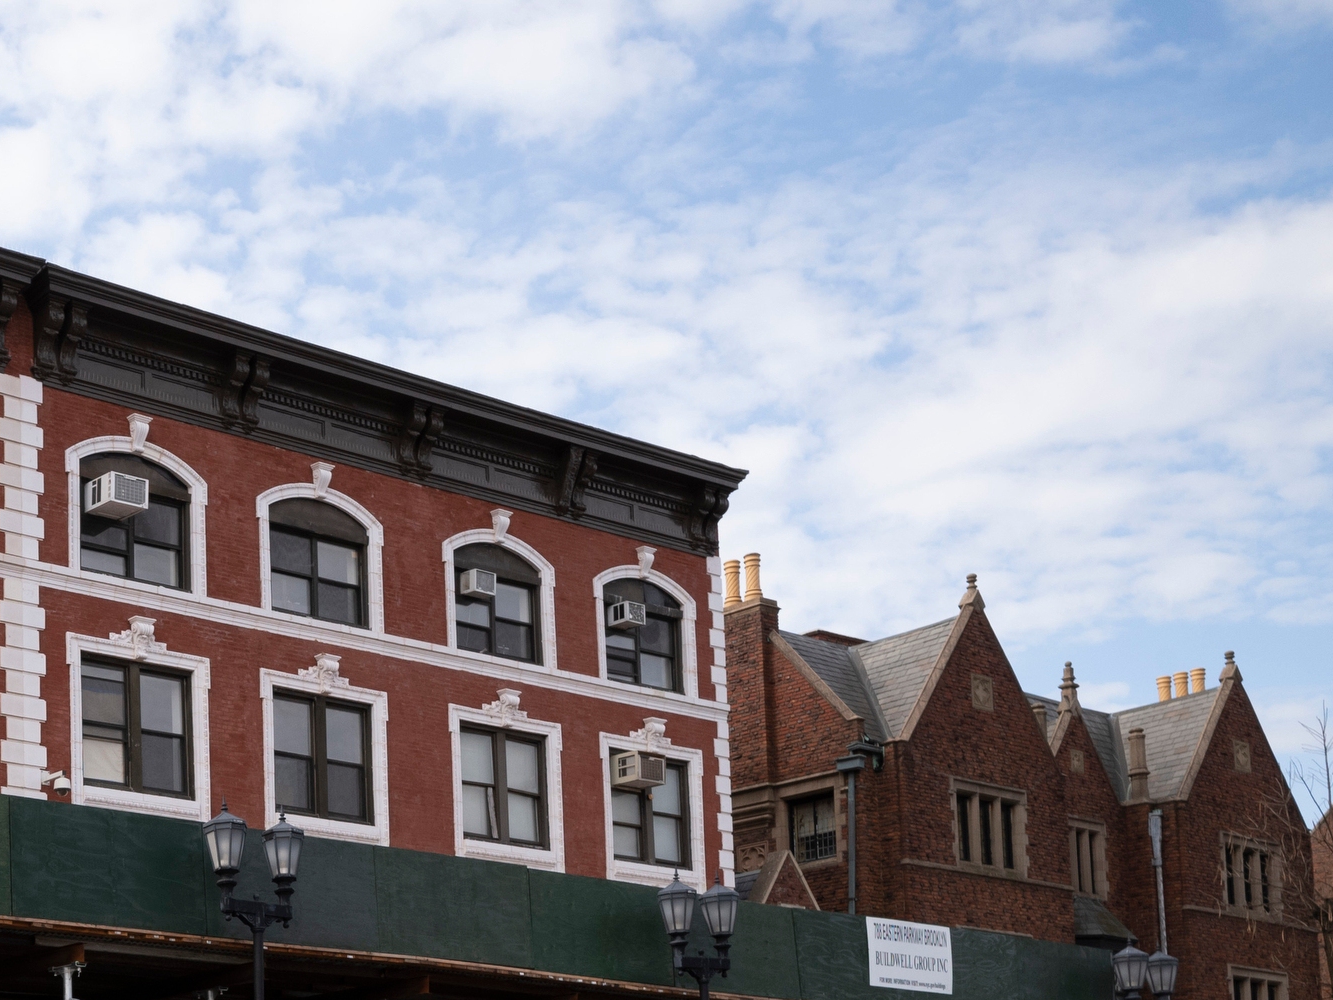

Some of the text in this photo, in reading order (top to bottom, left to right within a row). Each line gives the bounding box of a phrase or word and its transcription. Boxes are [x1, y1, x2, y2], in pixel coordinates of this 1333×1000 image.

[882, 923, 903, 942] EASTERN
[903, 926, 924, 945] PARKWAY
[924, 929, 948, 948] BROOKLYN
[875, 950, 948, 973] BUILDWELL GROUP INC
